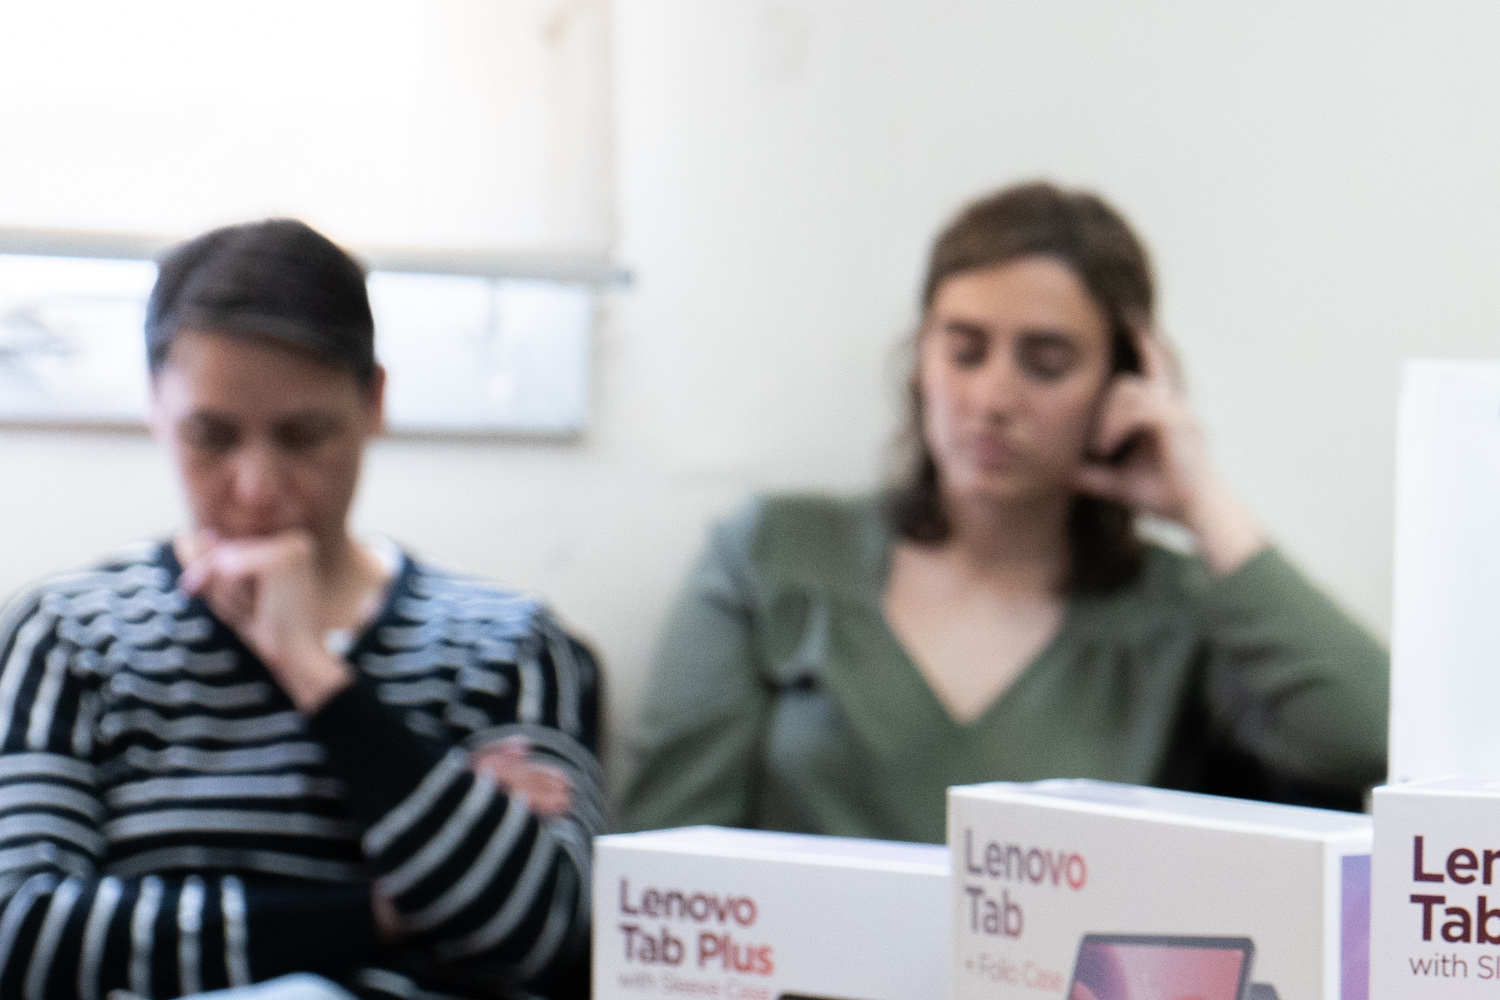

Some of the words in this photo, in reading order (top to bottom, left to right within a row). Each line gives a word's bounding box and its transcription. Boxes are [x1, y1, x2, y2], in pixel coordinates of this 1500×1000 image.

[965, 828, 1087, 890] Lenovo
[619, 876, 757, 927] Lenovo
[965, 885, 1024, 939] Tab
[619, 923, 684, 966] Tab
[698, 932, 774, 976] Plus
[1410, 954, 1468, 977] with
[1022, 960, 1064, 992] Case
